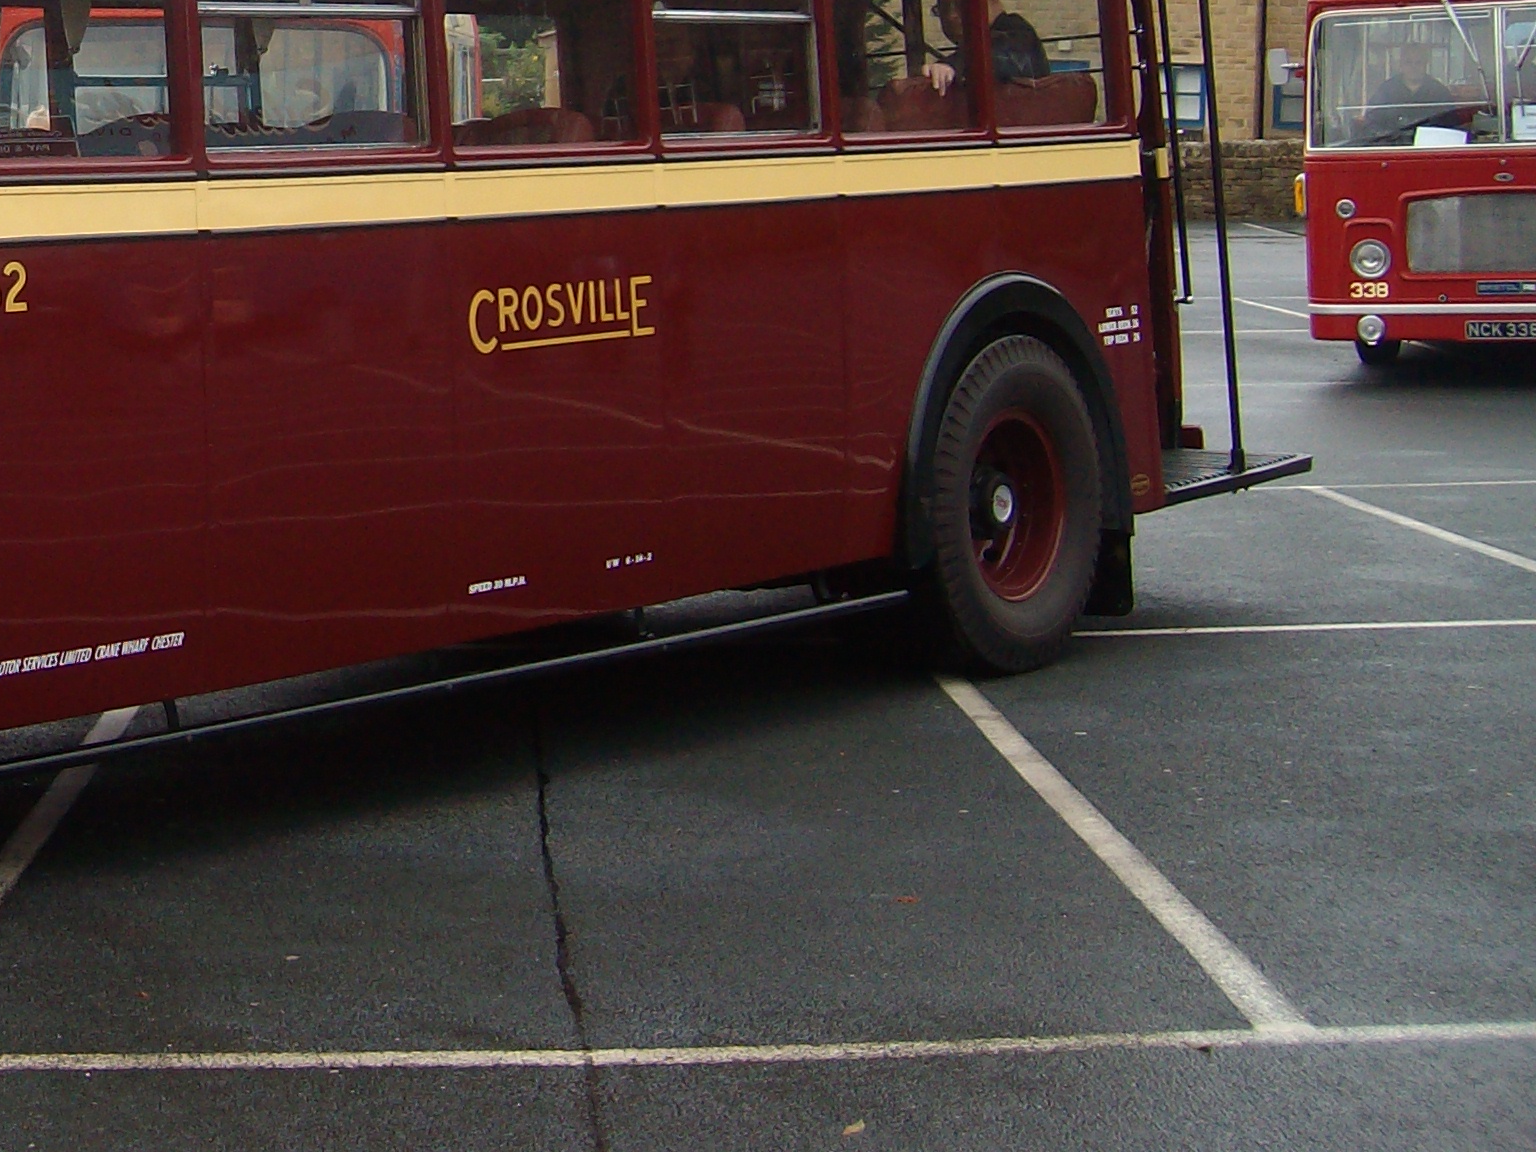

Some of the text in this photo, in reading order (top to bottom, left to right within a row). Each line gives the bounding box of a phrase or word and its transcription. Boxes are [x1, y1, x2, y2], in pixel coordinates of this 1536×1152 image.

[1350, 281, 1389, 299] 338
[467, 275, 657, 355] CROSVILLE
[1468, 322, 1503, 337] NCK
[21, 651, 60, 673] SERVICES
[59, 646, 92, 667] LIMITED
[94, 641, 122, 661] CRANE
[121, 636, 150, 656] WHARF
[151, 631, 185, 651] CHESTER
